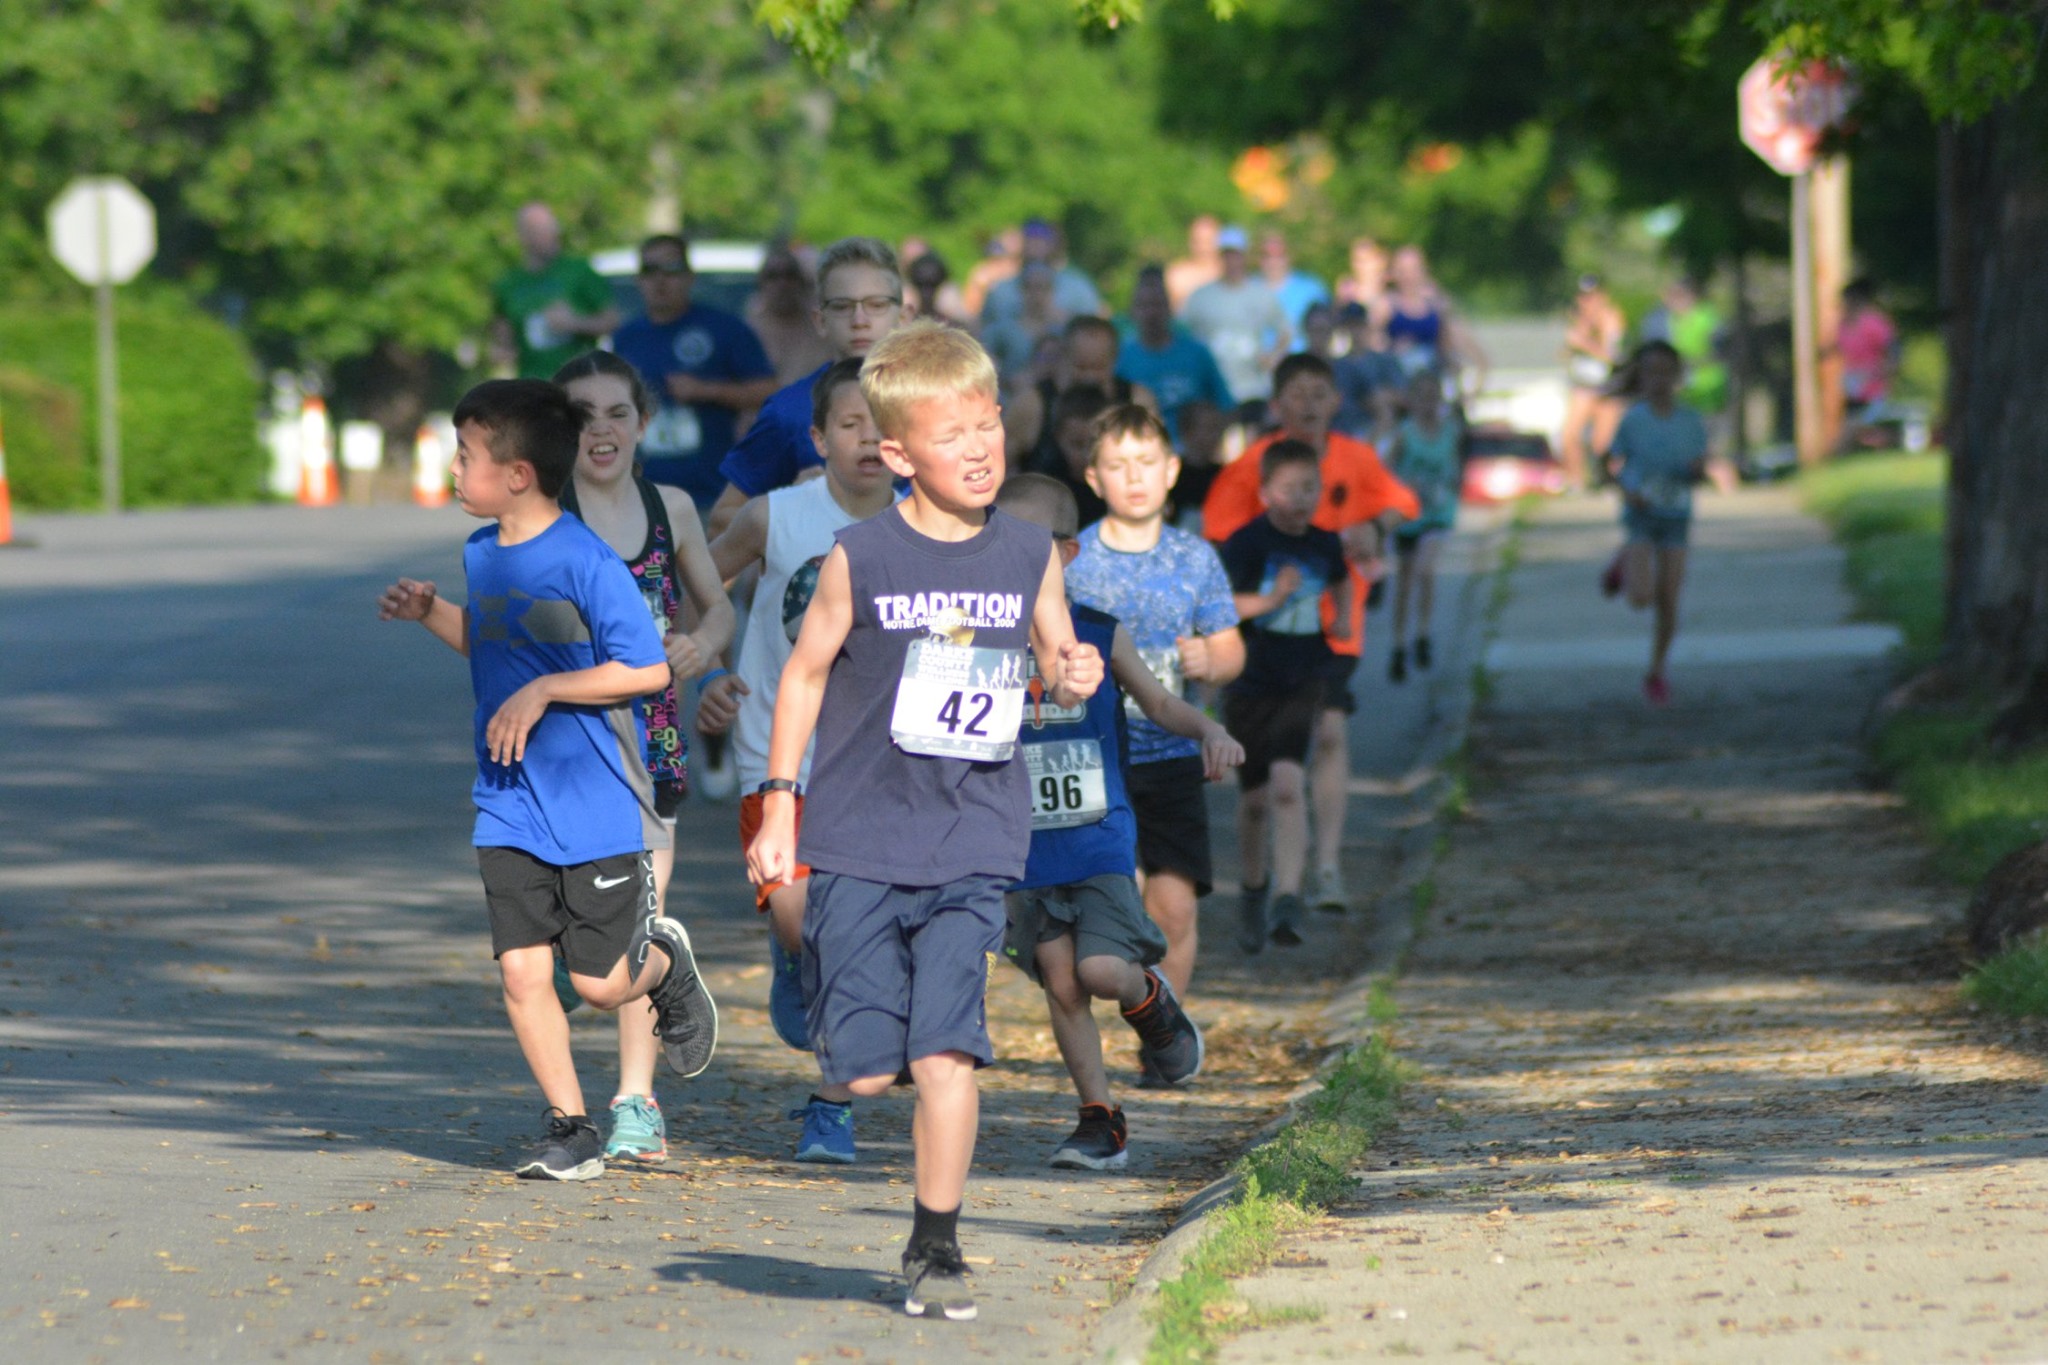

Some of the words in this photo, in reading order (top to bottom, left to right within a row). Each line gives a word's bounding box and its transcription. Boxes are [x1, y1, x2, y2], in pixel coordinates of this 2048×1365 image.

[874, 592, 1022, 621] TRADITION
[882, 618, 916, 630] NOTRE
[937, 691, 994, 737] 42
[1031, 774, 1082, 813] 96
